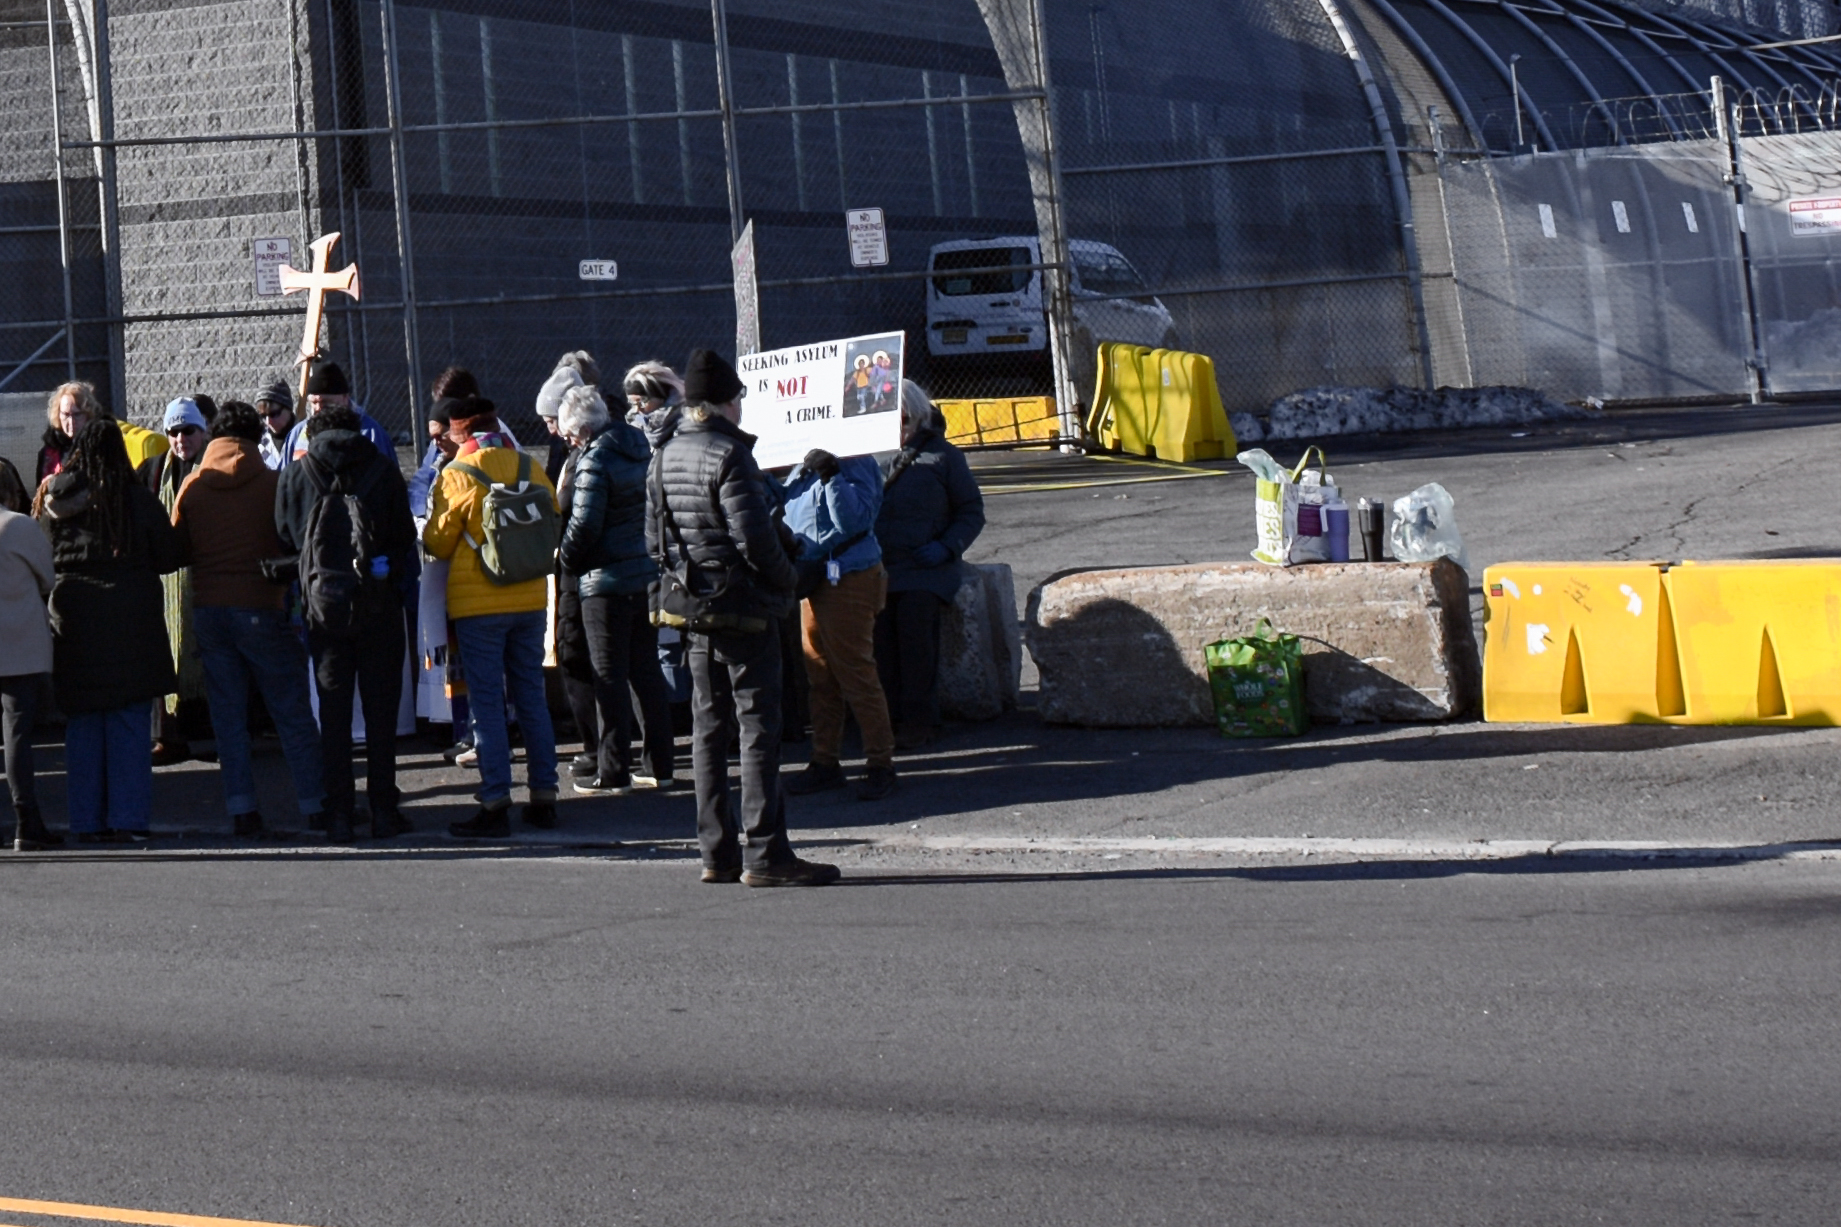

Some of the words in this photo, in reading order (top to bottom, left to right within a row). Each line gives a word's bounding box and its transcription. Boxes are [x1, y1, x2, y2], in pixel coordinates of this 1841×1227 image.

[860, 213, 870, 222] NO
[851, 223, 882, 232] PARKING
[266, 242, 278, 251] NO
[256, 252, 289, 261] PARKING
[581, 264, 605, 276] GATE
[608, 264, 615, 276] 4
[742, 353, 789, 373] SEEKING
[793, 344, 838, 364] ASYLUM
[758, 378, 769, 393] IS
[776, 375, 809, 400] NOT
[784, 410, 792, 424] A
[796, 405, 836, 423] CRIME.
